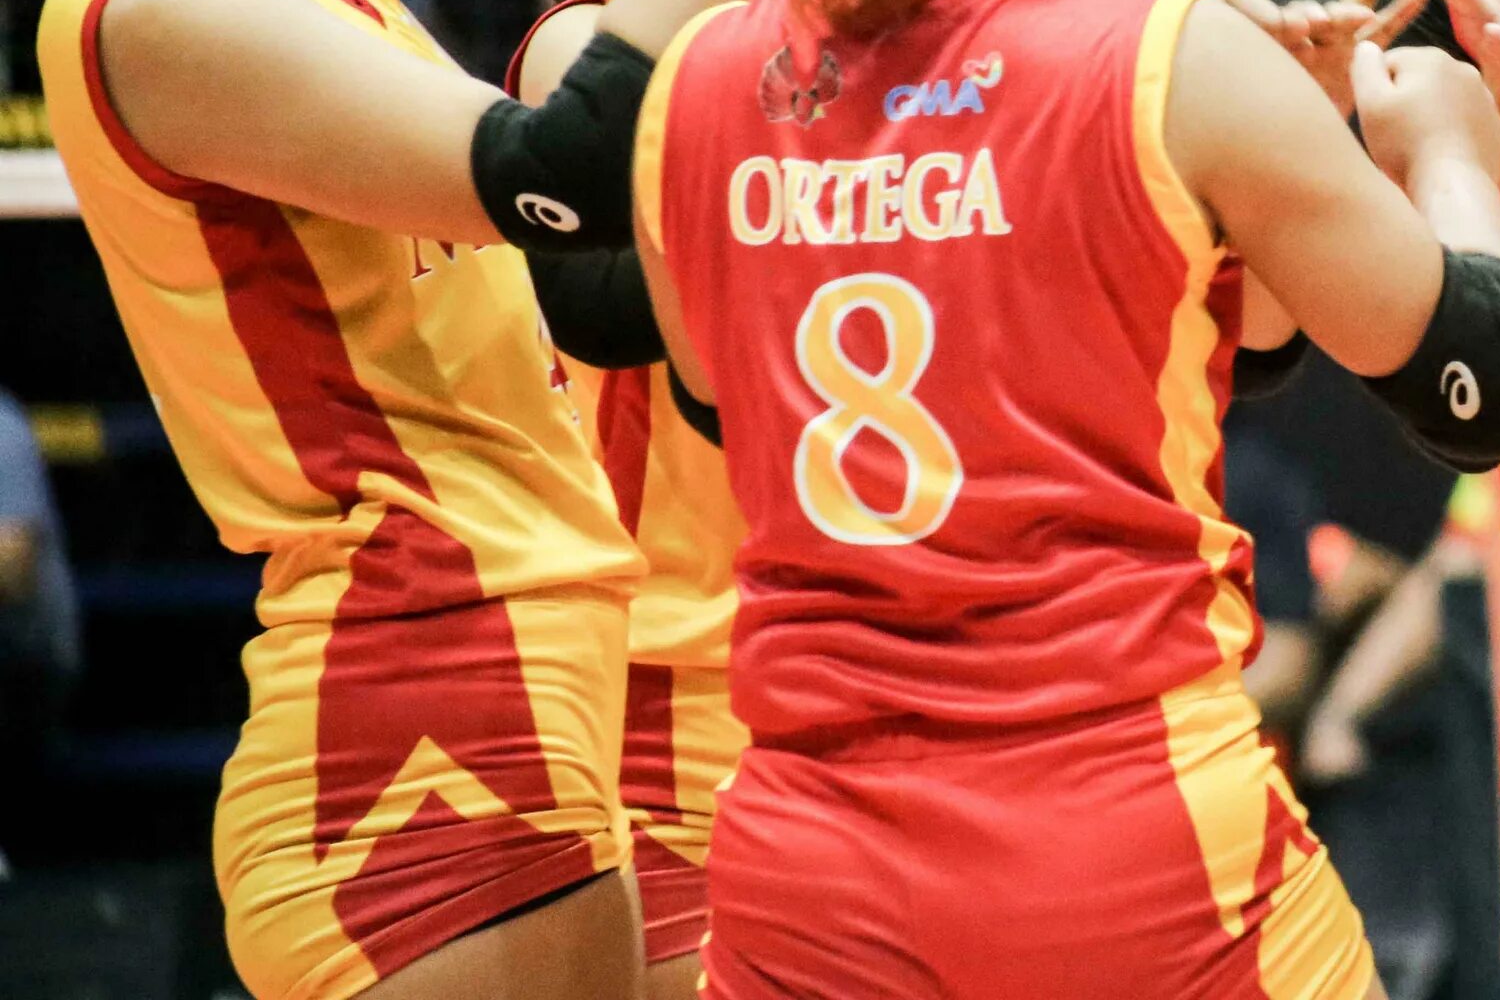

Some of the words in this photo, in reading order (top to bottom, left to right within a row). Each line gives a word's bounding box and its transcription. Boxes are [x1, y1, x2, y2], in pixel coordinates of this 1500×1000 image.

[884, 79, 985, 121] GMA
[729, 149, 1012, 245] ORTEGA
[794, 273, 963, 545] 8
